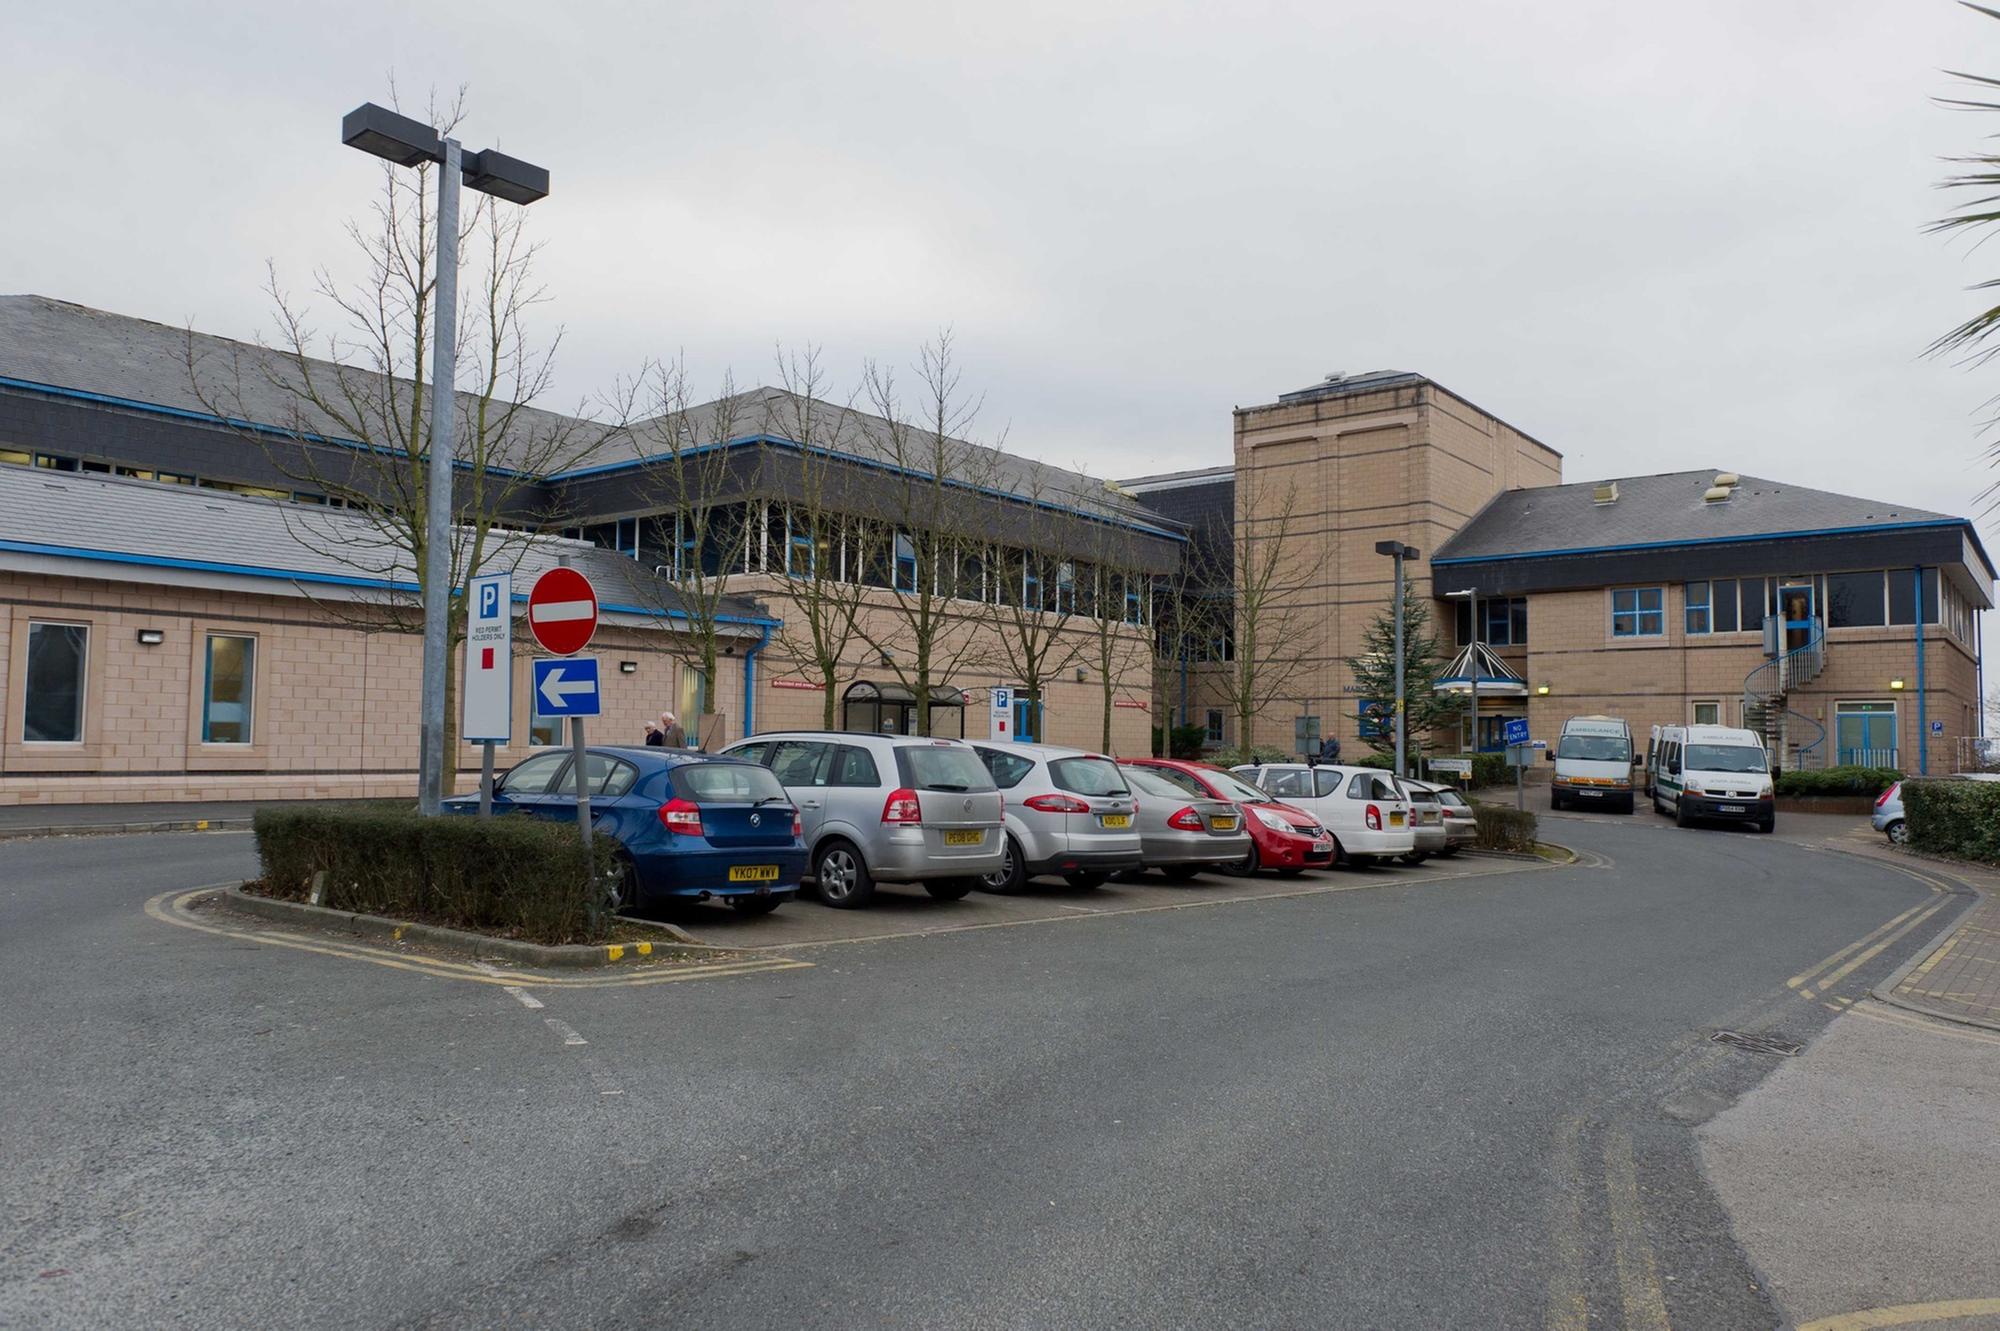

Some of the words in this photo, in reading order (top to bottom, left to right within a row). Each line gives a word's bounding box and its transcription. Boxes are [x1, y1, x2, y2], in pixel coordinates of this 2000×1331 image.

[483, 586, 495, 615] P
[485, 625, 502, 633] PERMIT
[472, 633, 493, 641] HOLDERS
[998, 692, 1006, 706] P
[1512, 724, 1522, 732] NO
[1569, 727, 1620, 735] AMBULANCE
[1934, 722, 1941, 731] P
[1509, 731, 1528, 741] ENTRY
[734, 867, 758, 879] YK07
